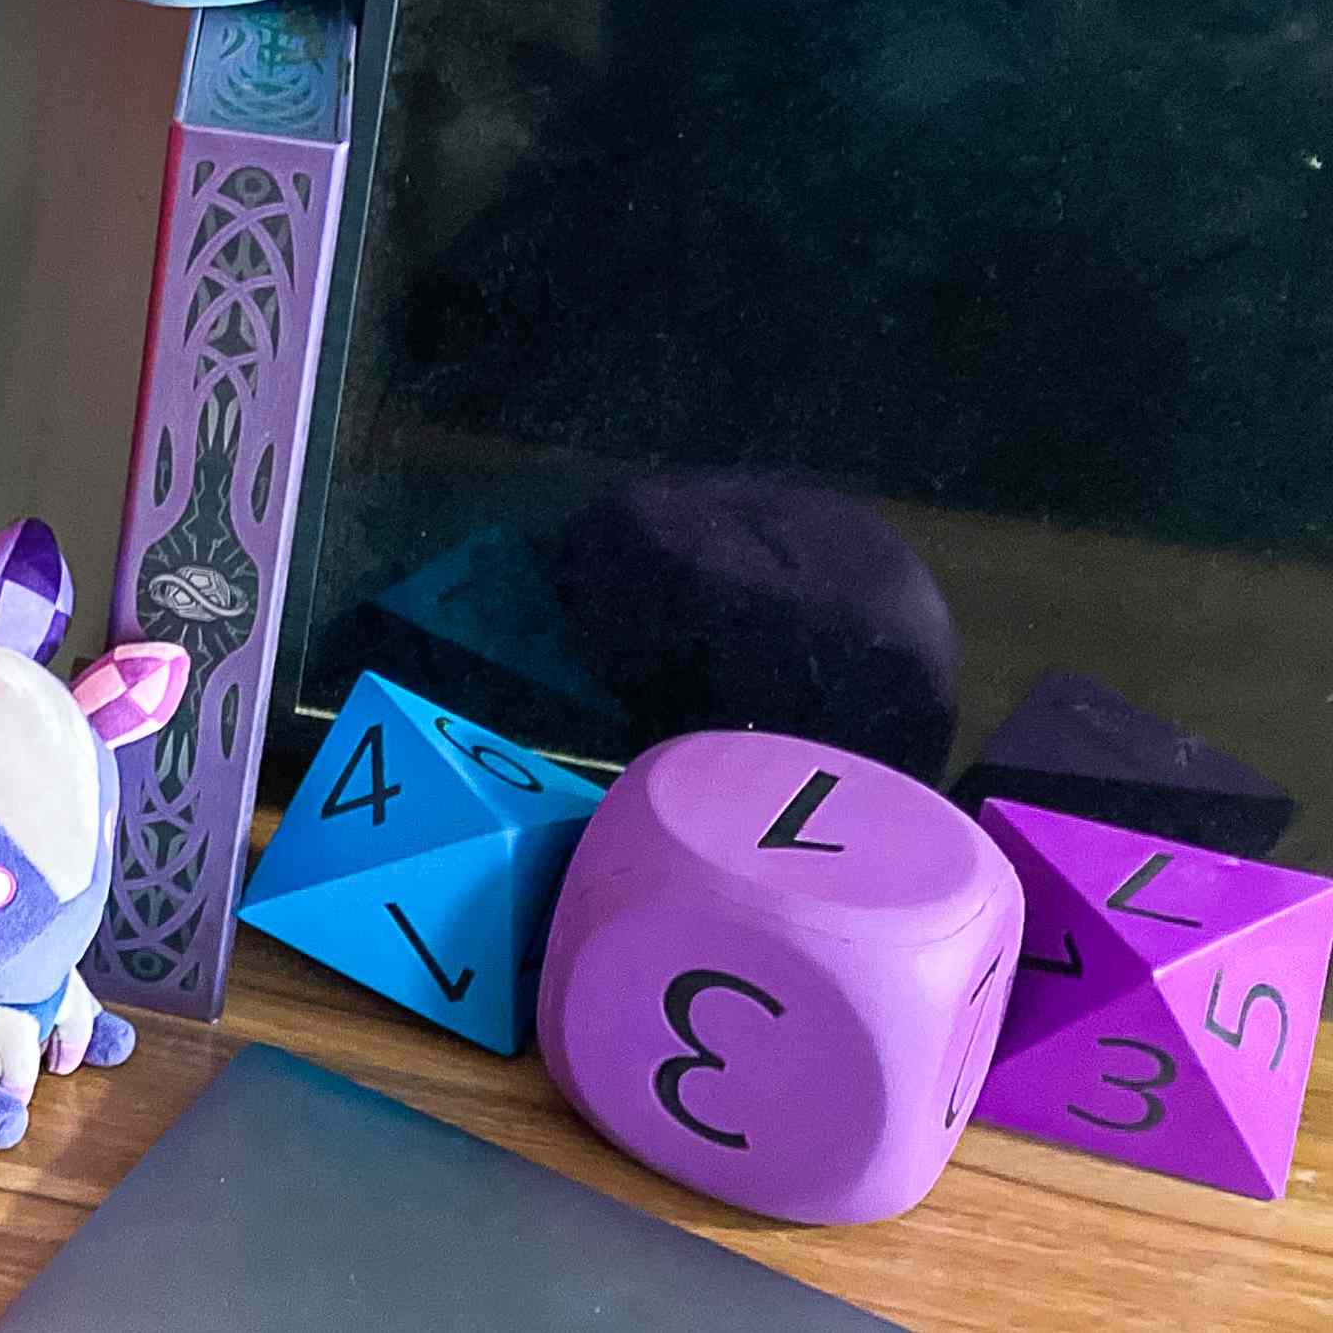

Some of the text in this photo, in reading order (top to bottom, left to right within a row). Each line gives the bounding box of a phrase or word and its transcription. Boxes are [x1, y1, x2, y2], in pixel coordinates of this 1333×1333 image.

[320, 722, 402, 827] 4
[434, 717, 544, 794] 6
[654, 968, 785, 1151] 3
[1204, 968, 1288, 1072] 5
[1066, 1036, 1178, 1134] 3
